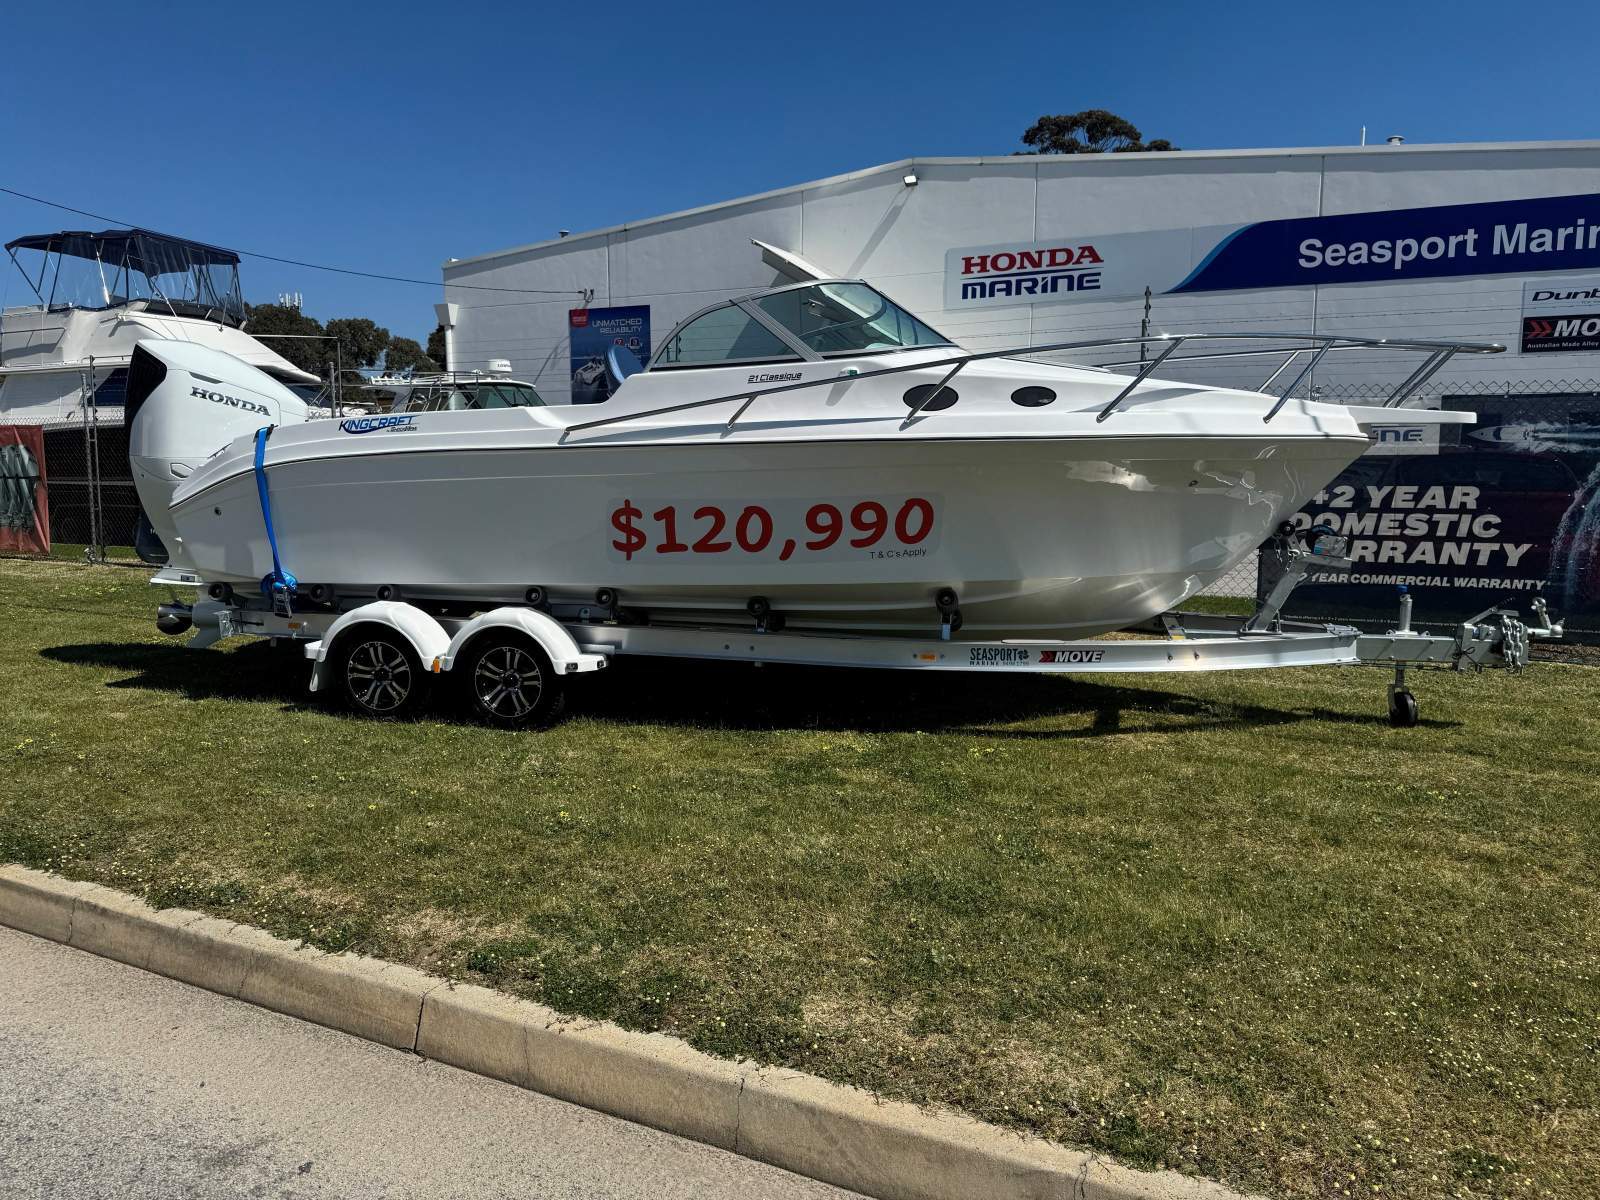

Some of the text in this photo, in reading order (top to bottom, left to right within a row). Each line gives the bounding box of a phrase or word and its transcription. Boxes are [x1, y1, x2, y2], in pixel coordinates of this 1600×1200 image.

[1298, 228, 1479, 270] Seasport
[960, 245, 1104, 275] HONDA
[961, 271, 1102, 300] MARINE
[591, 317, 642, 328] UNMATCHED
[600, 325, 642, 334] RELIABILITY
[1582, 340, 1600, 348] Alloy
[189, 386, 271, 416] HONDA
[338, 415, 417, 433] KINGCRAFT
[1366, 485, 1481, 509] YEAR
[611, 498, 935, 562] $120,990
[870, 551, 876, 559] T
[877, 550, 884, 559] &
[902, 547, 927, 558] Apply
[1300, 540, 1534, 567] RRANTY
[1311, 572, 1349, 583] YEAR
[1350, 573, 1450, 587] COMMERCIAL
[1454, 576, 1547, 591] WARRANTY
[969, 647, 1103, 663] SEASPORT MOVE
